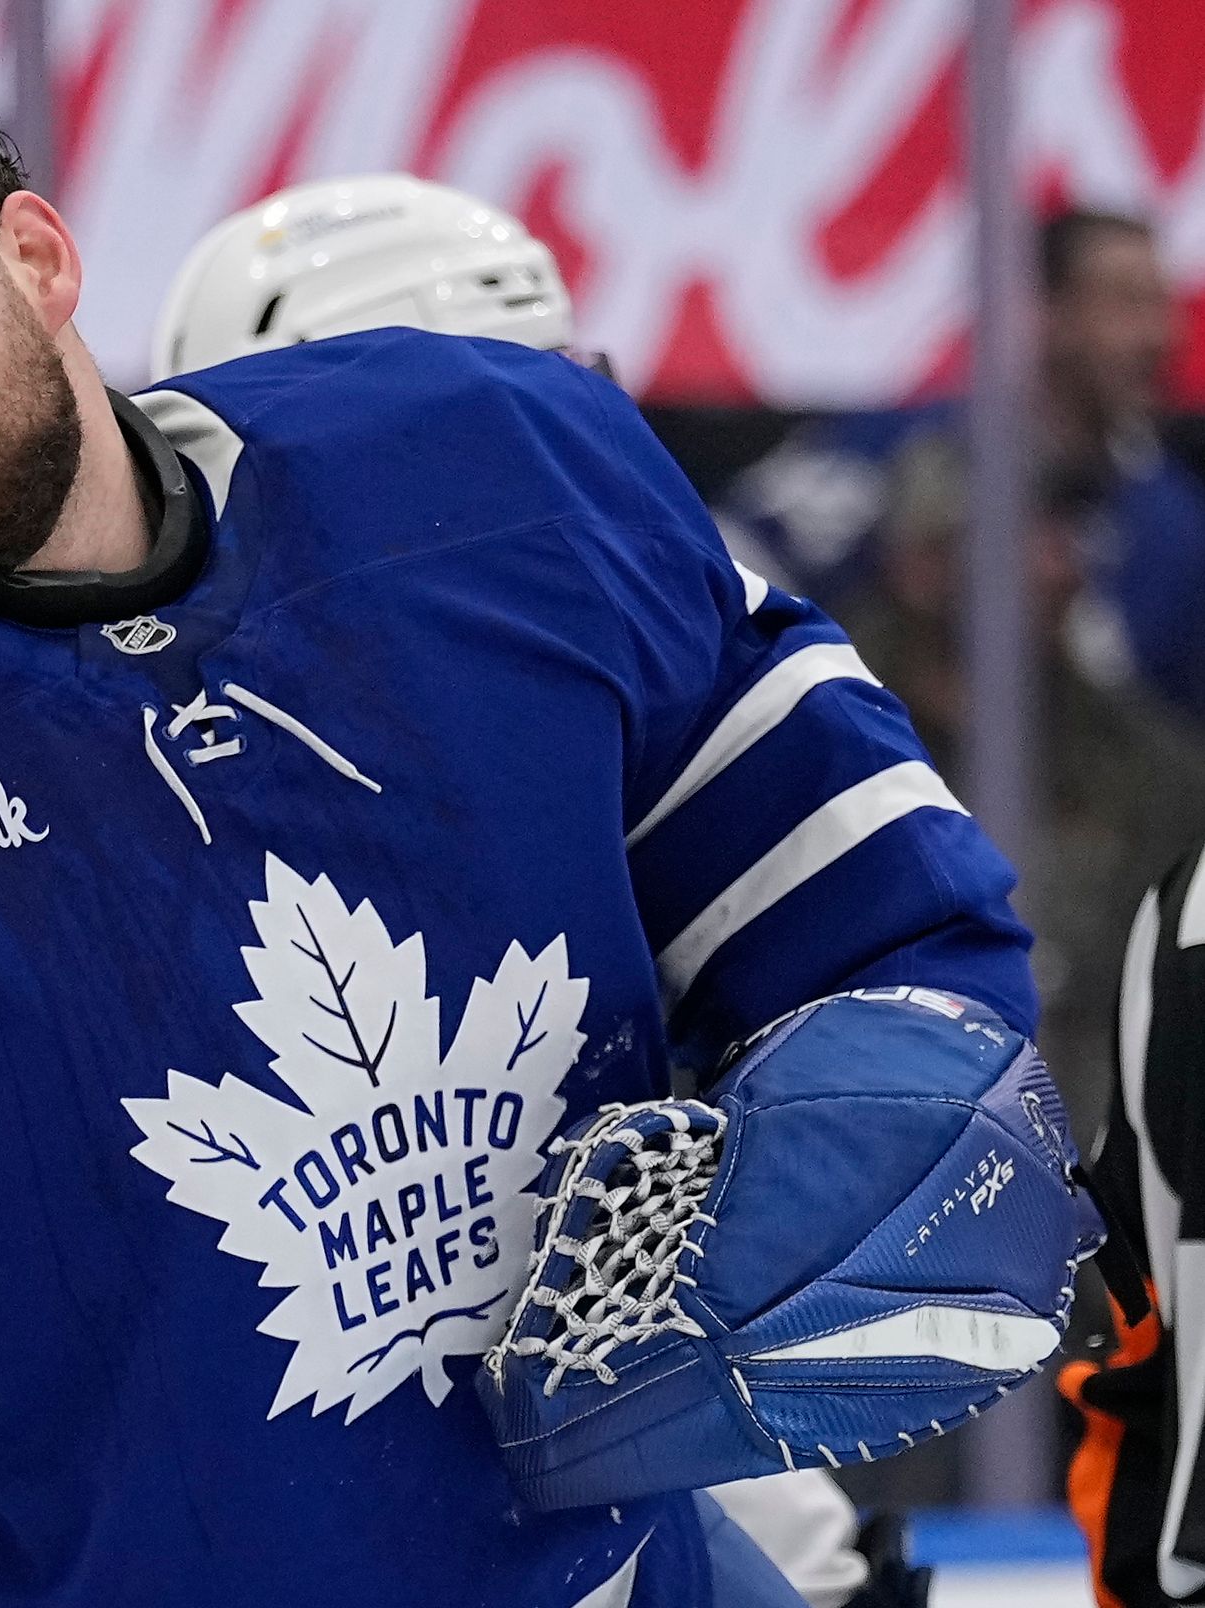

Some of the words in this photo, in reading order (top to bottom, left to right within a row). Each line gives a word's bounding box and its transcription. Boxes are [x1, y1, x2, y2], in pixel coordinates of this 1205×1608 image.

[258, 1088, 524, 1233] TORONTO
[318, 1154, 494, 1270] MAPLE
[905, 1149, 997, 1257] CATALYST
[332, 1215, 500, 1332] LEAFS
